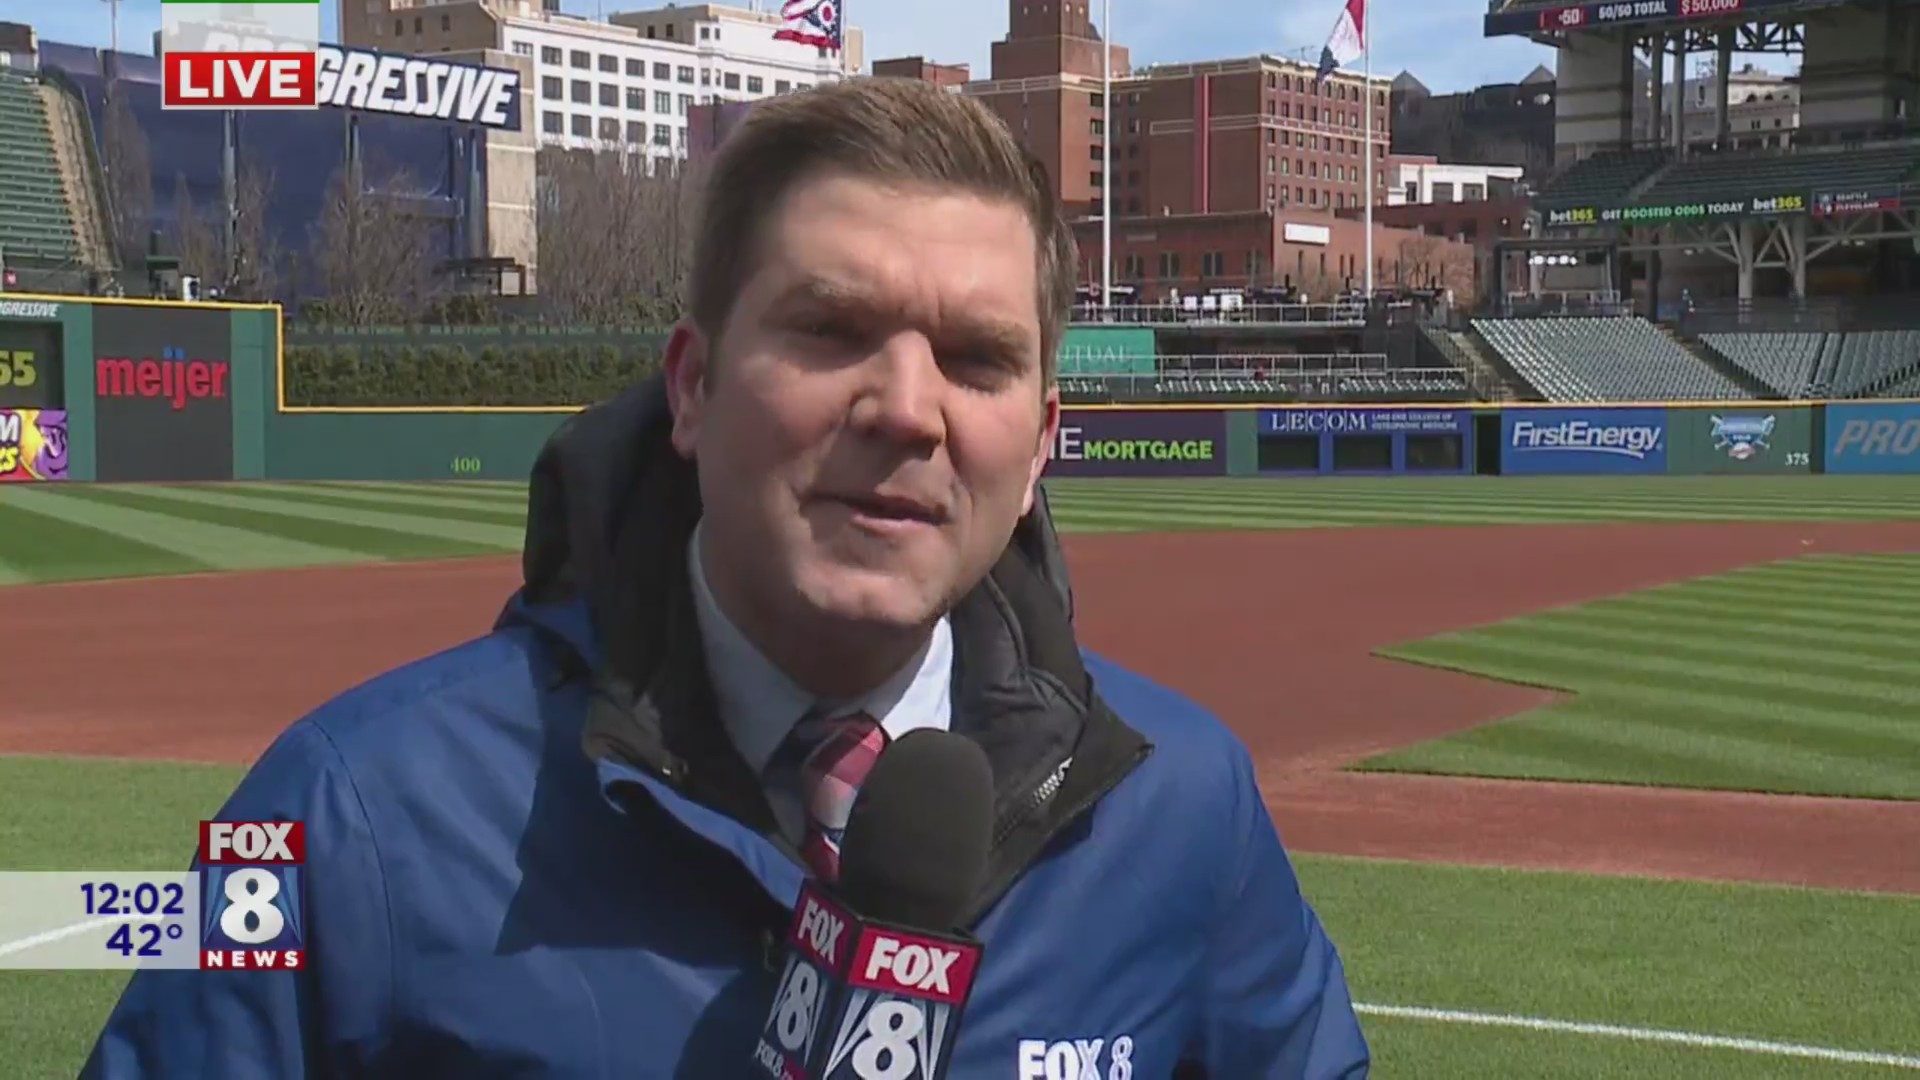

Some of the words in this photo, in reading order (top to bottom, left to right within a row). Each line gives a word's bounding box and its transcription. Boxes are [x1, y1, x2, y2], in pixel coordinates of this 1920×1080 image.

[1599, 4, 1632, 20] 50/50
[1634, 1, 1667, 15] TOTAL
[1550, 207, 1594, 222] bet365
[1602, 209, 1621, 220] GET
[1623, 207, 1672, 219] BOOSTED
[1675, 205, 1705, 216] ODDS
[1707, 202, 1744, 214] TODAY
[1753, 196, 1802, 211] bet365
[97, 347, 228, 410] meijer
[1084, 440, 1213, 460] MORTGAGE
[1512, 421, 1662, 451] FirstEnergy
[1785, 452, 1810, 466] 375
[797, 899, 845, 966] FOX
[865, 936, 960, 995] FOX
[776, 961, 819, 1051] 8
[852, 1000, 924, 1080] 8
[1018, 1038, 1105, 1080] FOX
[1109, 1035, 1134, 1080] 8
